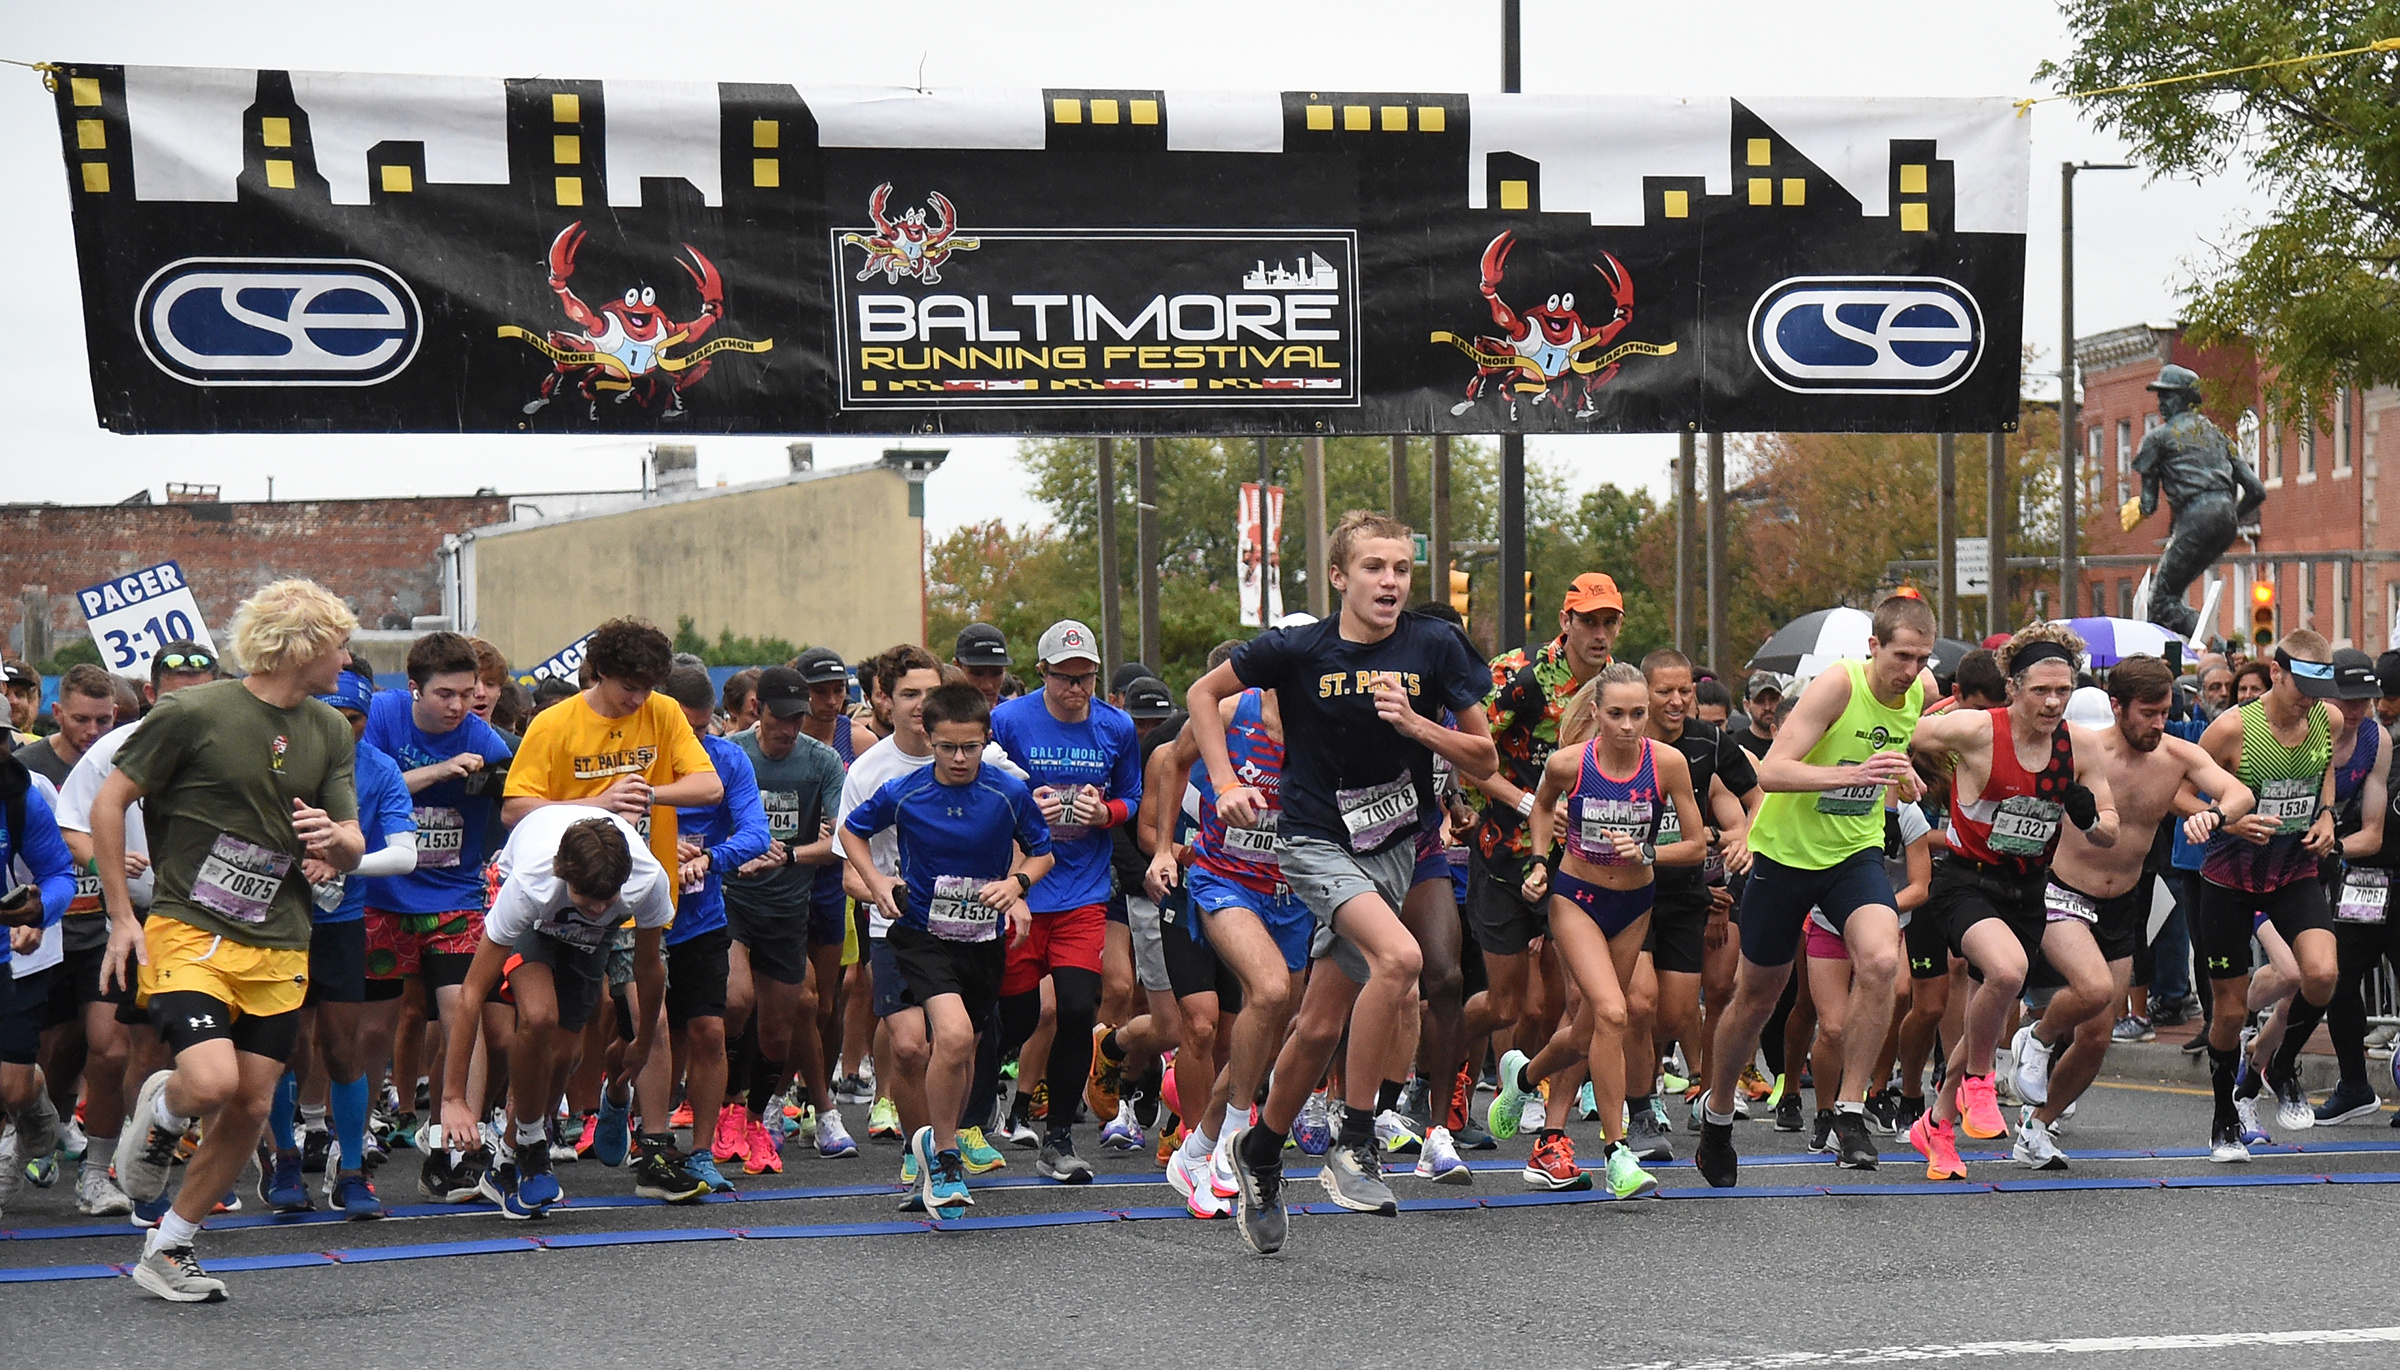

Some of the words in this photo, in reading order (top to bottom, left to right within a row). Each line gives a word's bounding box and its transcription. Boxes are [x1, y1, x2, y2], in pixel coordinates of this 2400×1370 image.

[859, 295, 1339, 341] BALTIMORE
[521, 330, 596, 363] BALTIMORE
[685, 338, 755, 366] MARATHON
[630, 350, 638, 367] 1
[862, 346, 1087, 371] RUNNING
[1103, 346, 1340, 370] FESTIVAL
[1452, 336, 1516, 366] BALTIMORE
[1594, 343, 1661, 369] MARATHON
[1546, 353, 1554, 370] 1
[82, 565, 182, 617] PACER
[104, 609, 195, 669] 3:10
[1319, 672, 1350, 698] ST.
[1030, 747, 1104, 760] BALTIMORE
[574, 757, 594, 773] ST.
[1362, 788, 1414, 826] 70078
[2279, 799, 2308, 816] 1538
[2013, 818, 2047, 839] 1321
[415, 831, 459, 849] 71533
[1242, 832, 1274, 851] 700
[219, 868, 276, 899] 70875
[2354, 888, 2383, 903] 70061
[948, 903, 995, 921] 71532
